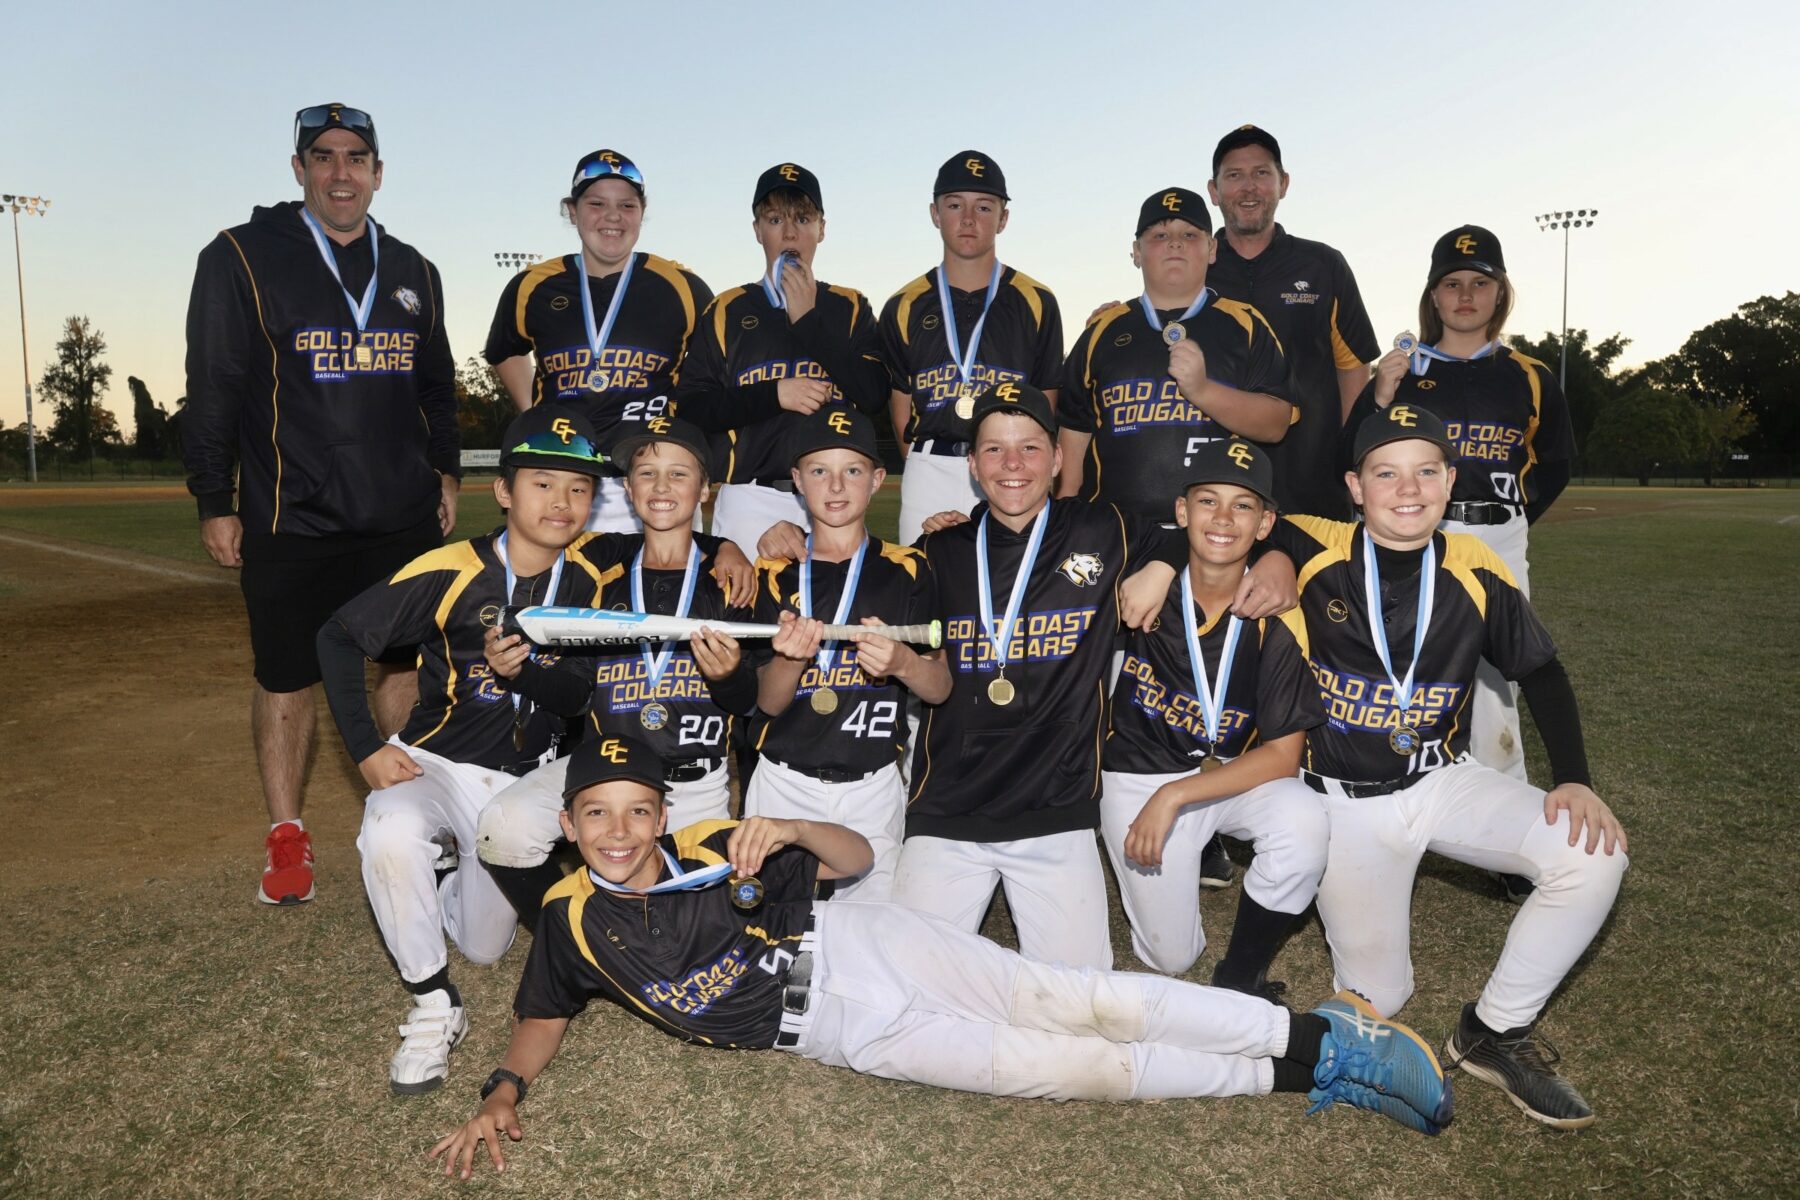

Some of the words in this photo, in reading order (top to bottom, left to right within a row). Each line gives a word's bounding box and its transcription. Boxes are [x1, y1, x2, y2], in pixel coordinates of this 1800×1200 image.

[295, 331, 353, 351] GOLD
[361, 332, 420, 351] COAS
[314, 352, 414, 371] COUARS
[543, 349, 591, 374] GOLD
[600, 349, 669, 372] COAST
[557, 370, 648, 391] COUARS
[1102, 382, 1152, 408] GOLD
[622, 396, 668, 421] 29
[1114, 402, 1211, 426] COUGAR
[1013, 610, 1097, 637] COAST
[597, 661, 649, 684] GOLD
[612, 702, 639, 710] BASEBALL
[679, 715, 723, 746] 20
[841, 700, 898, 738] 42
[1407, 739, 1444, 775] 10
